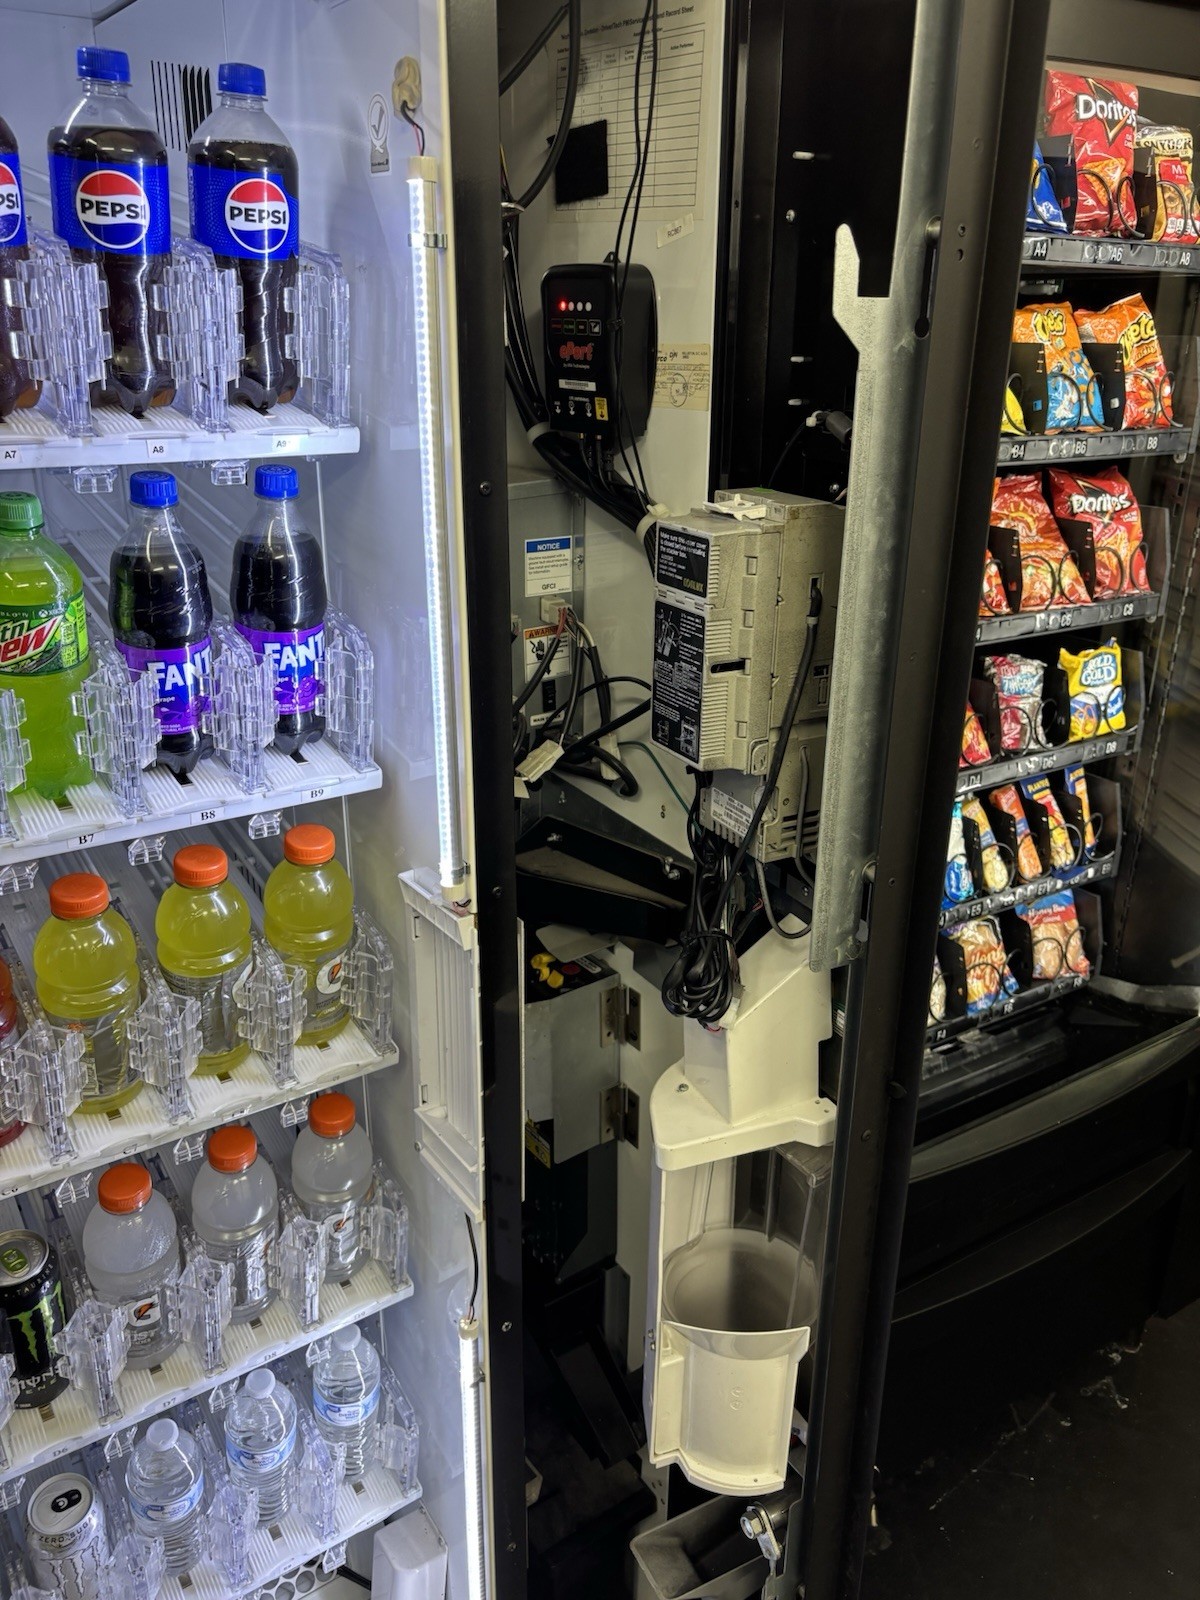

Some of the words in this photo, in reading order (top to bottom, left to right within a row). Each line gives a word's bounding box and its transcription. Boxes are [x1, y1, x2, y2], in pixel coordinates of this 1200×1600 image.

[1078, 94, 1136, 127] Doritos
[0, 192, 19, 209] PSI
[80, 197, 147, 220] PEPSI
[229, 205, 287, 225] PEPSI
[1034, 243, 1047, 257] A4
[1111, 247, 1123, 262] A6
[1179, 252, 1191, 266] A8
[152, 446, 164, 454] A8
[276, 440, 288, 448] A9
[1075, 440, 1087, 454] B6
[1147, 437, 1158, 450] B8
[4, 450, 17, 460] A7
[1013, 445, 1024, 458] B4
[1070, 492, 1132, 514] Doritos
[537, 542, 560, 551] NOTICE
[542, 582, 556, 590] GFCI
[1123, 604, 1134, 616] C8
[1060, 614, 1072, 627] C6
[0, 617, 57, 662] ew
[976, 628, 981, 640] 4
[262, 630, 324, 672] FANT
[148, 646, 212, 691] FANT
[1081, 666, 1116, 685] GOLD
[1106, 740, 1117, 752] D8
[969, 775, 981, 785] D4
[310, 788, 324, 799] B9
[201, 810, 216, 821] B8
[78, 835, 94, 846] B7
[16, 1263, 55, 1297] TAURINE
[263, 1352, 278, 1362] D8
[162, 1397, 178, 1408] D7
[52, 1447, 68, 1458] D6
[38, 1536, 65, 1544] ZERO
[70, 1510, 97, 1539] SUGAR
